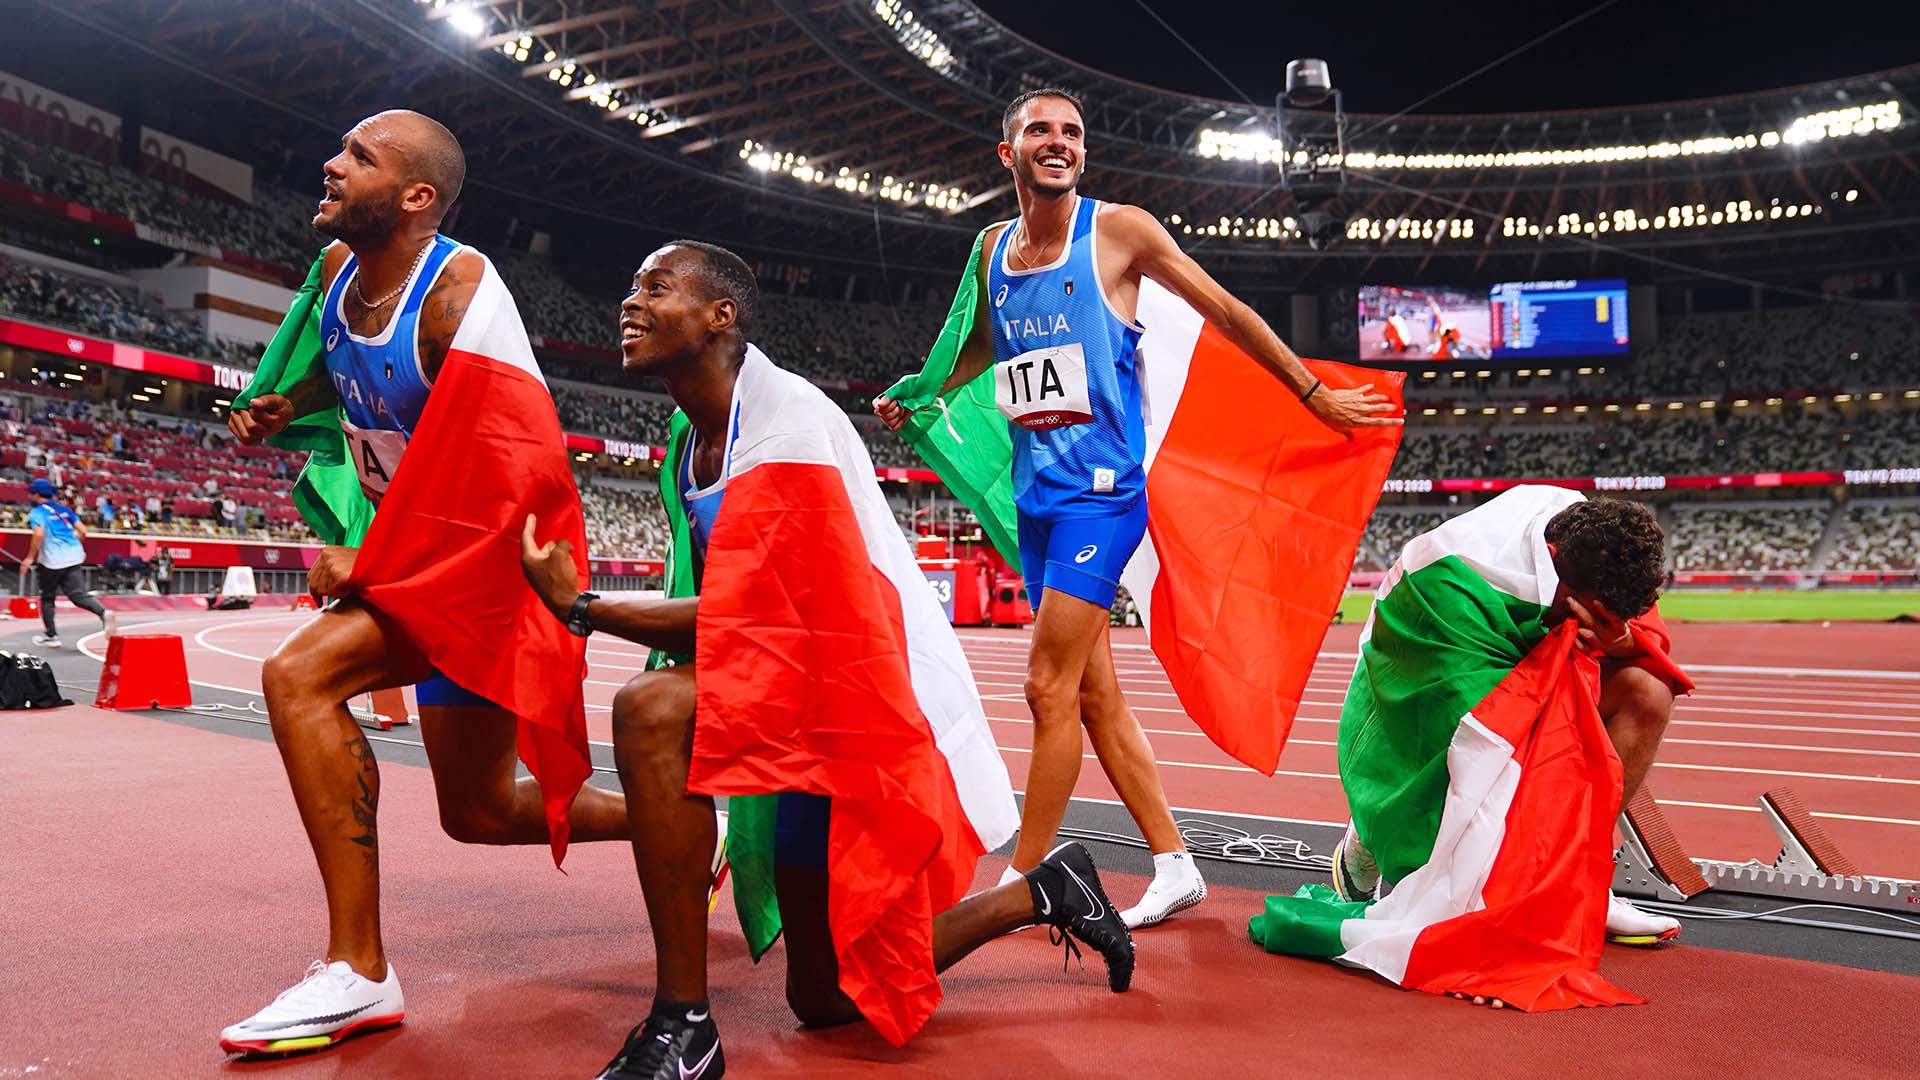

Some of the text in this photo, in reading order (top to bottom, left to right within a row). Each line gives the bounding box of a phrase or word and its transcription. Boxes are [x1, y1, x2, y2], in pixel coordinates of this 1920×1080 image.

[1005, 313, 1071, 340] ITALIA
[212, 365, 255, 391] TOKY
[1007, 358, 1065, 405] ITA
[333, 370, 391, 417] ITAIA
[604, 439, 650, 460] TOKYO 2020
[1404, 479, 1433, 492] 2020
[1593, 475, 1666, 490] TOKYO 2020
[1843, 469, 1889, 485] TOKYO
